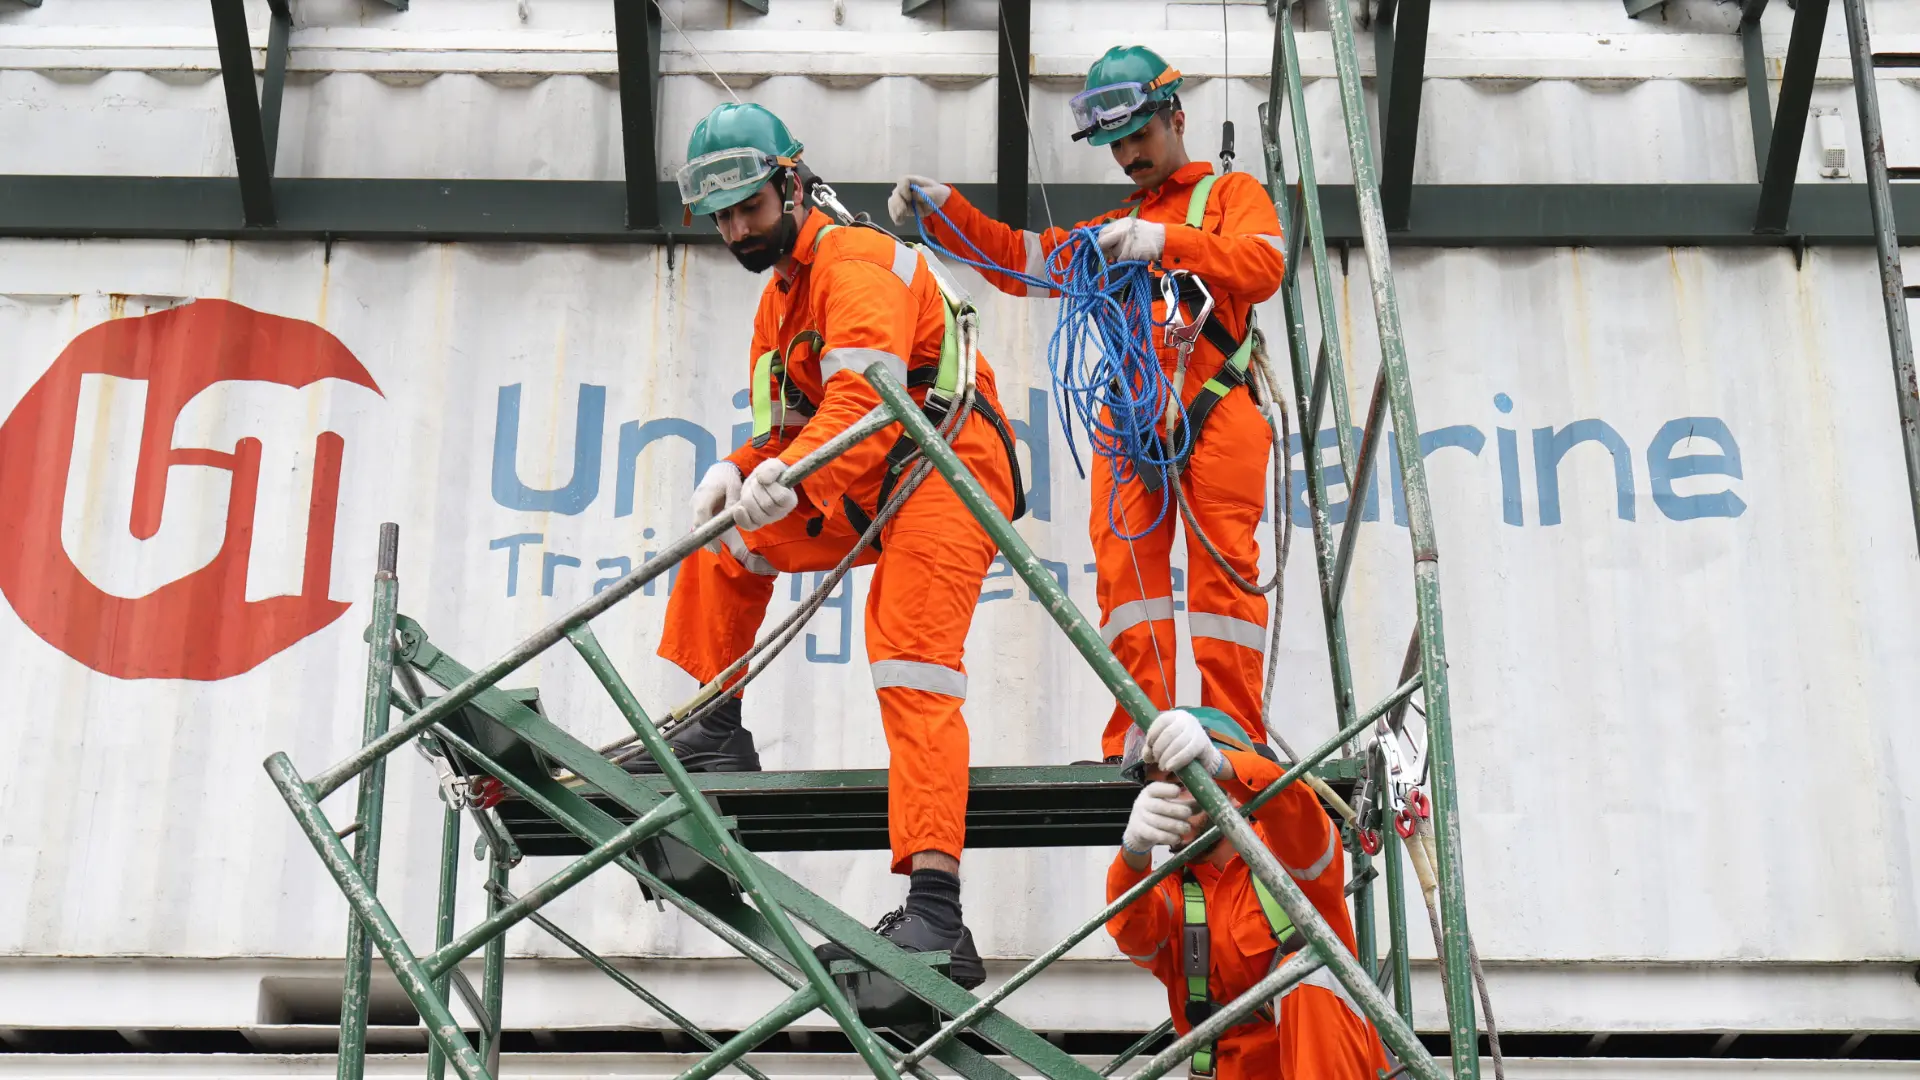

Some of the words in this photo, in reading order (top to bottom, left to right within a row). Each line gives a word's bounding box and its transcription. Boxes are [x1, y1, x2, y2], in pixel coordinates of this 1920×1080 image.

[491, 382, 1051, 522] Unid
[1262, 392, 1748, 529] arine
[489, 527, 853, 664] Traig
